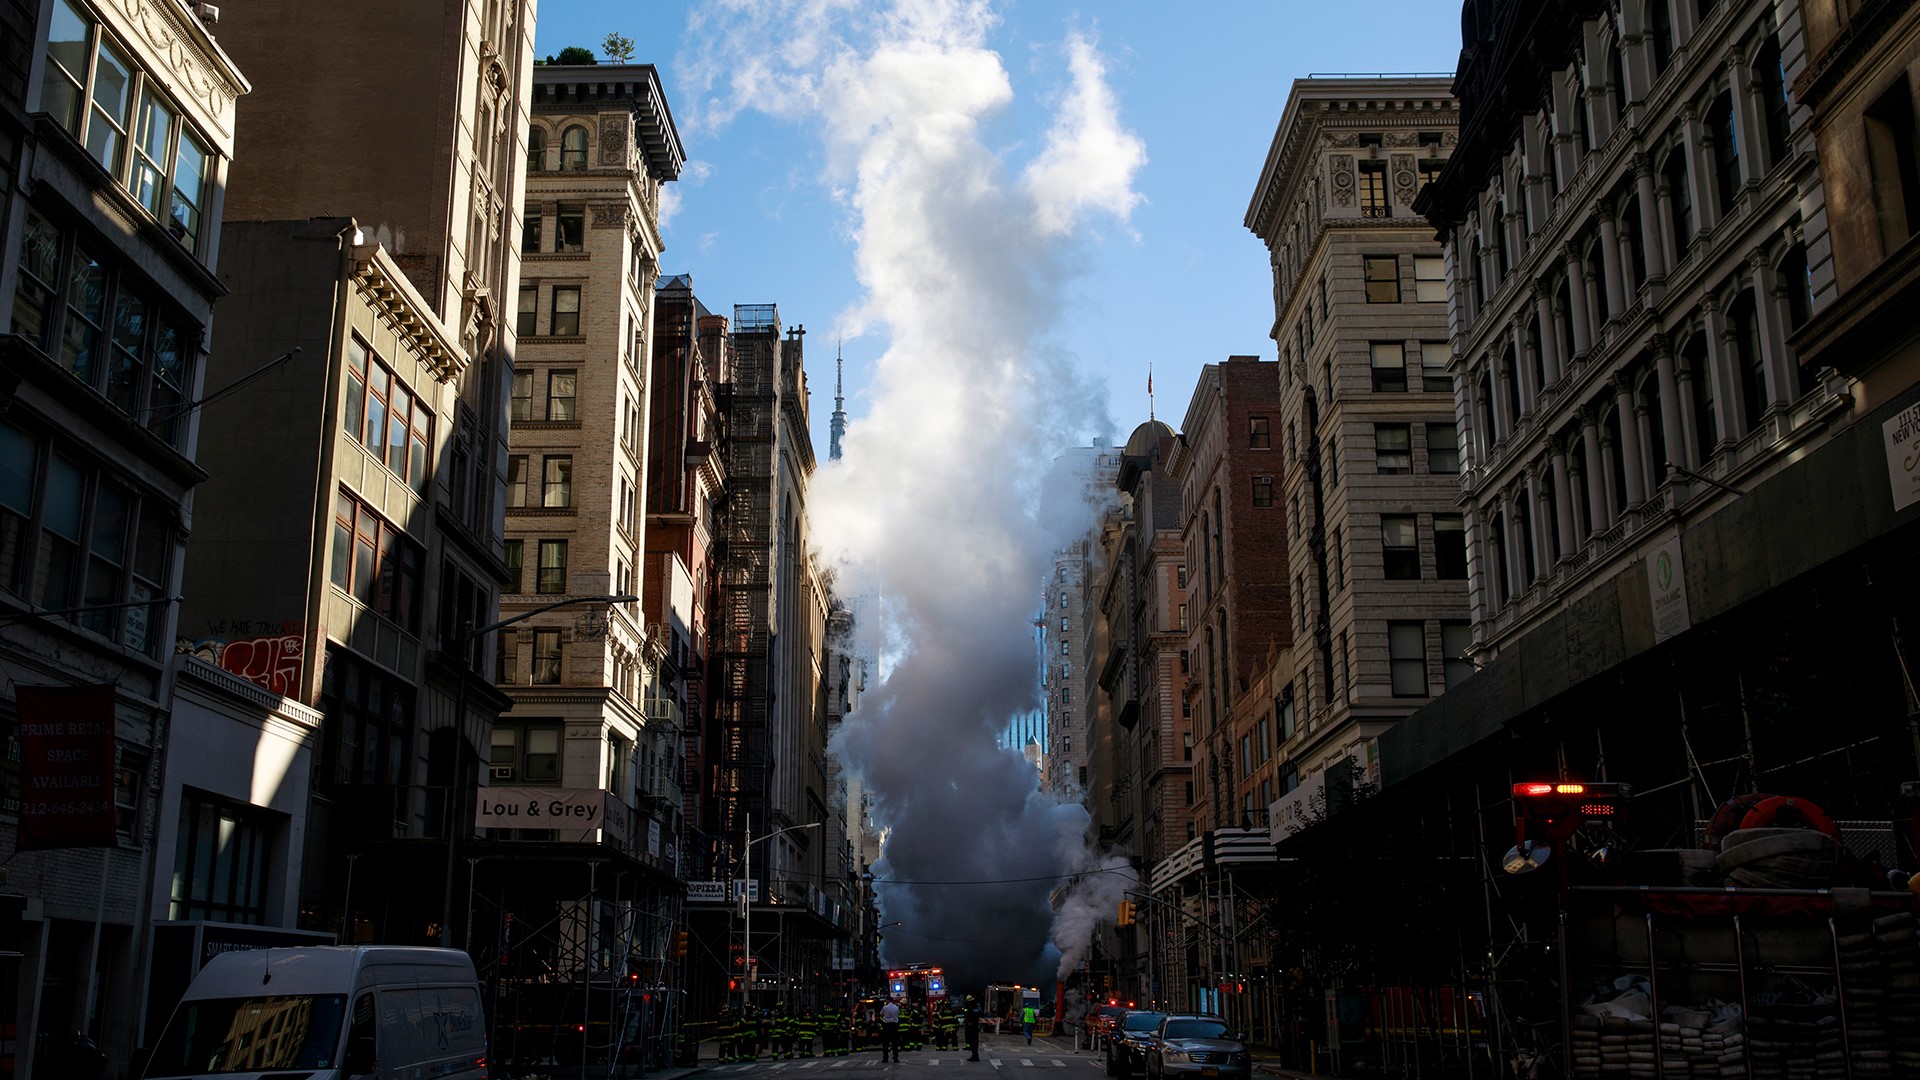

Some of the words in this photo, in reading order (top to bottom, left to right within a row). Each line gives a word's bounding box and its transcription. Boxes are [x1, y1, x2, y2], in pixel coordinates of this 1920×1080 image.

[1898, 411, 1913, 429] 111
[1893, 424, 1910, 446] NEW
[208, 620, 227, 635] WE
[230, 620, 253, 634] HATE
[20, 722, 65, 736] PRIME
[47, 749, 90, 762] SPACE
[31, 775, 103, 789] AVAILABLE
[21, 801, 109, 815] 212-645-3434
[482, 799, 519, 816] Lou
[526, 800, 540, 817] &
[548, 800, 598, 821] Grey
[696, 884, 724, 893] PIZZA
